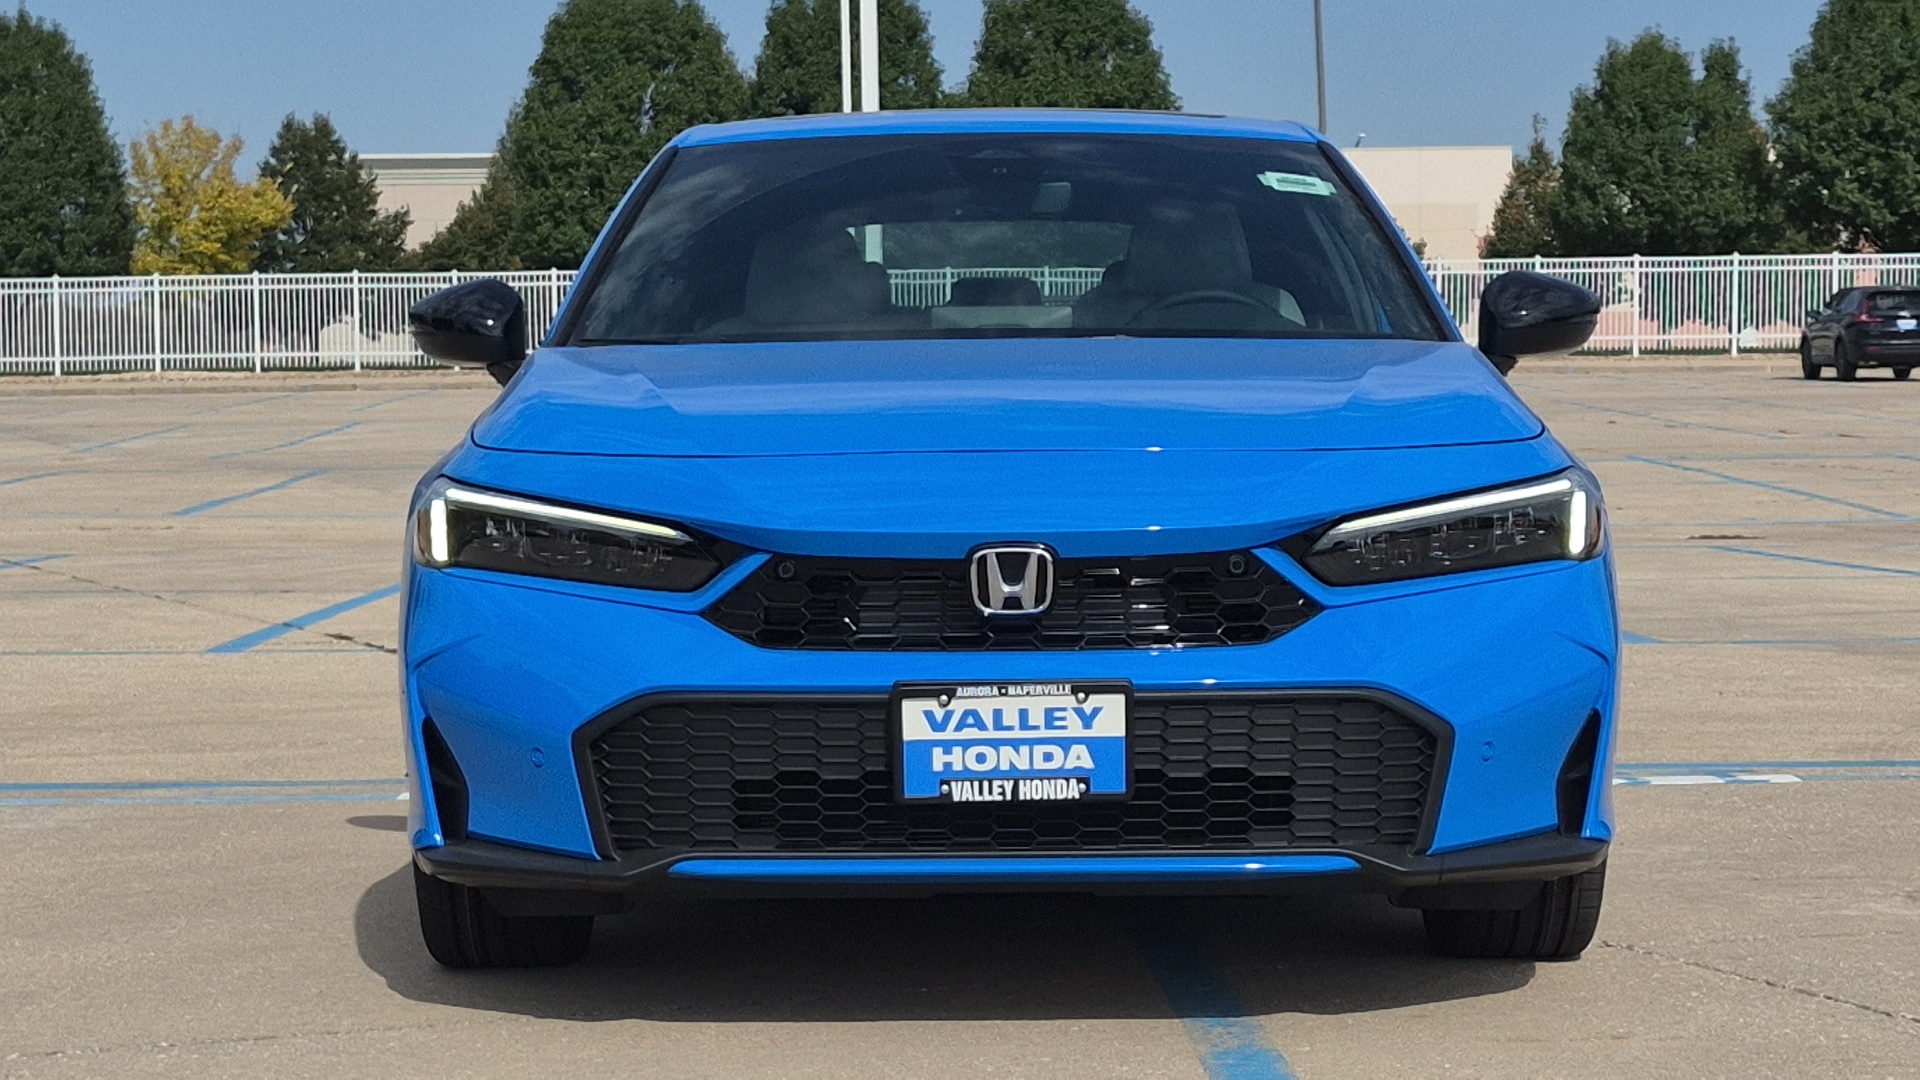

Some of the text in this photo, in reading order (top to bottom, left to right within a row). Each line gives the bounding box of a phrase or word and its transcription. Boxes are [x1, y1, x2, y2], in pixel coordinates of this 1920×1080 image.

[956, 684, 1072, 697] AURORA NAPERVILLE
[922, 706, 1104, 733] VALLEY
[932, 744, 1095, 771] HONDA
[951, 778, 1080, 802] VALLEY HONDA
